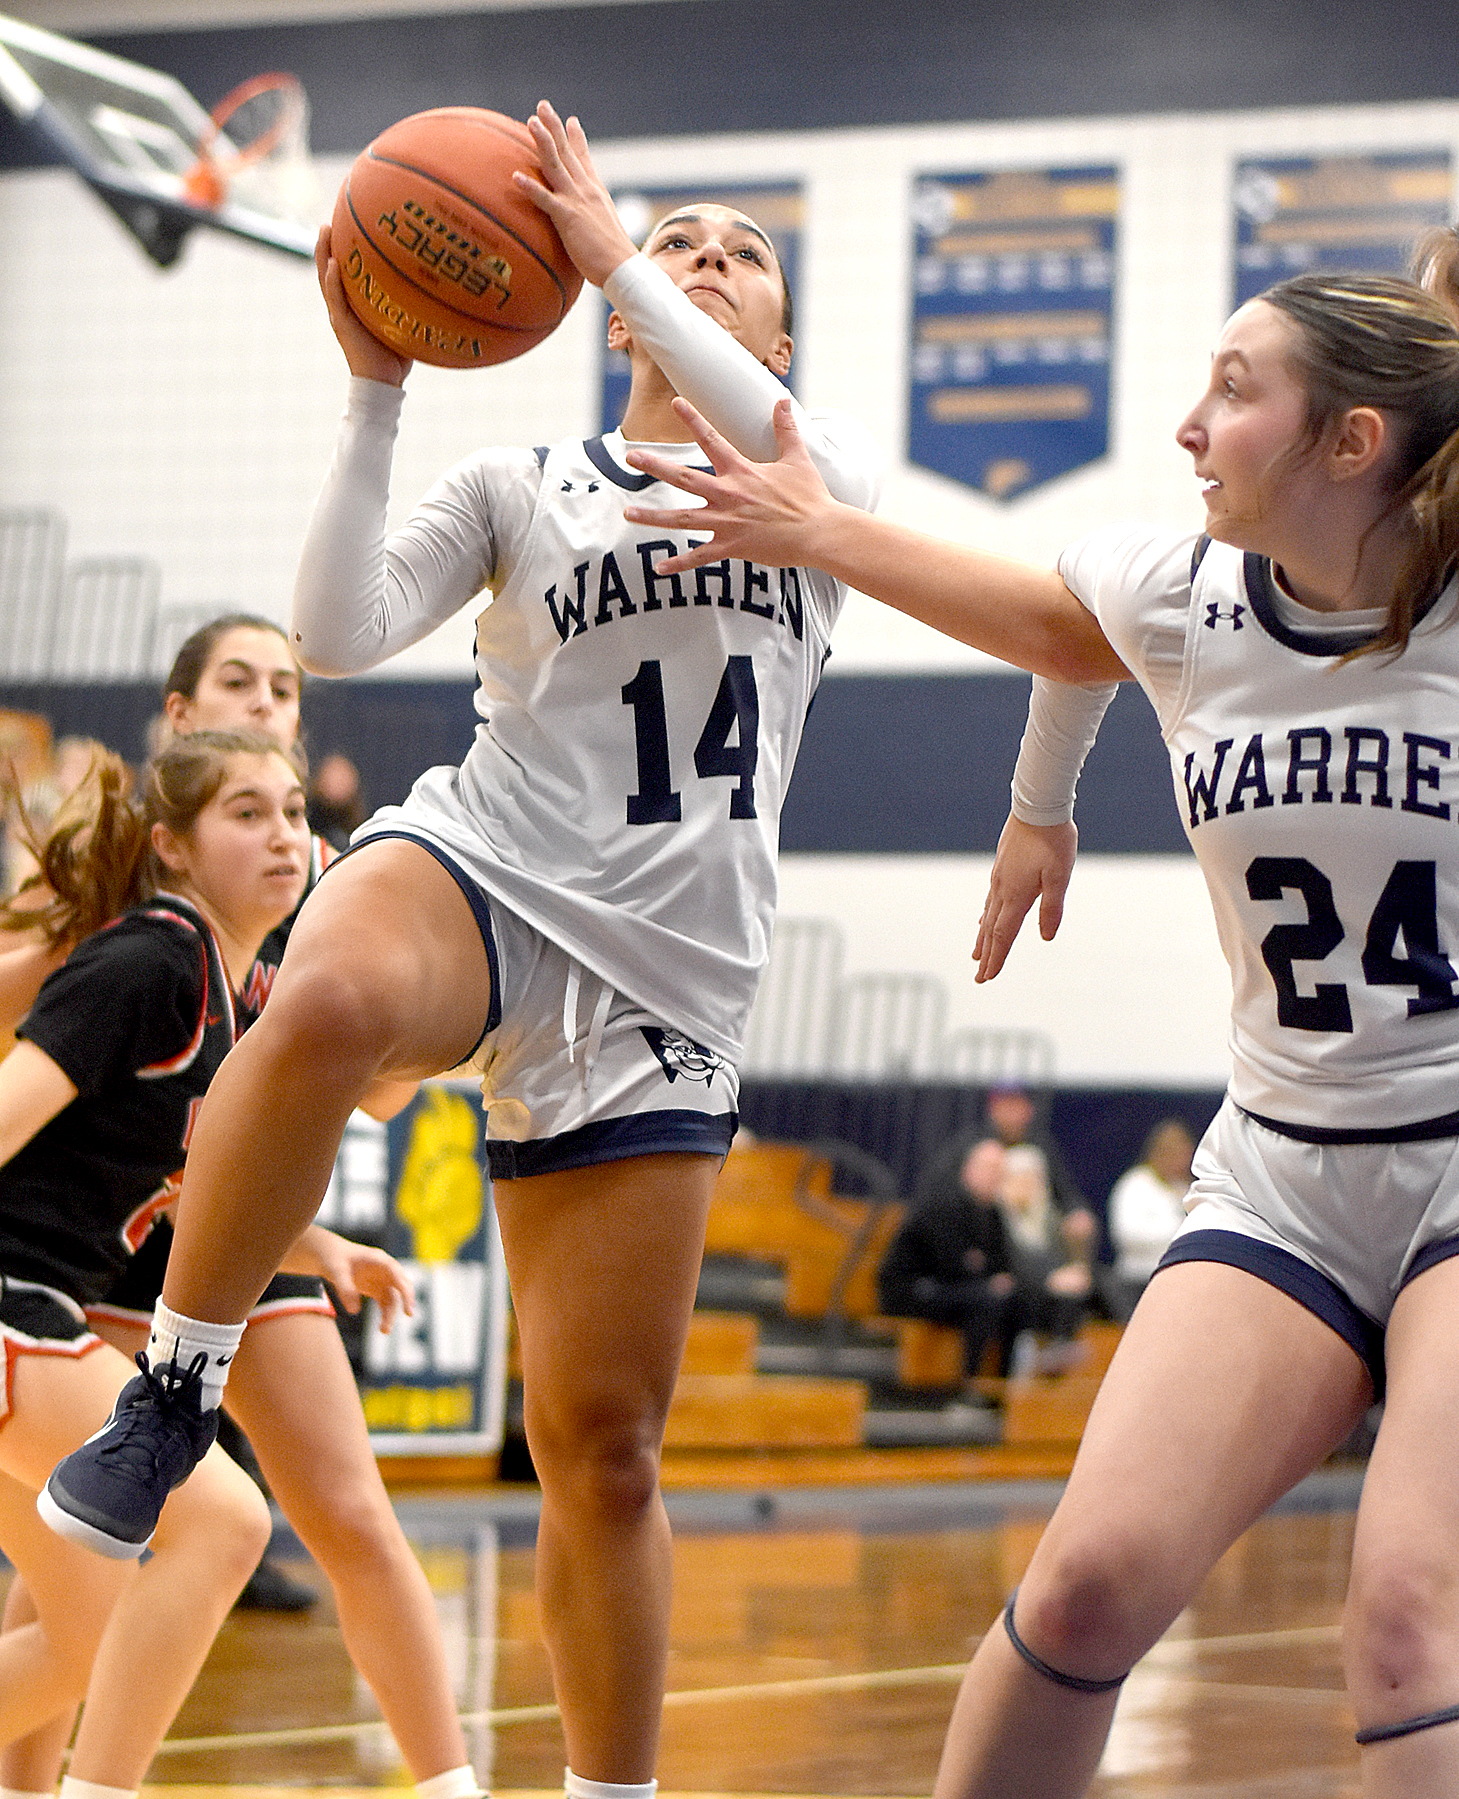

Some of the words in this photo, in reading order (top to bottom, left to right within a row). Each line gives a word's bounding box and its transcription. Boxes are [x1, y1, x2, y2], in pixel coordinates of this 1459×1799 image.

[377, 210, 511, 310] LEGACY
[544, 538, 803, 647] WARREN
[621, 655, 760, 825] 14
[1183, 726, 1459, 829] WARRE
[1244, 856, 1459, 1034] 24
